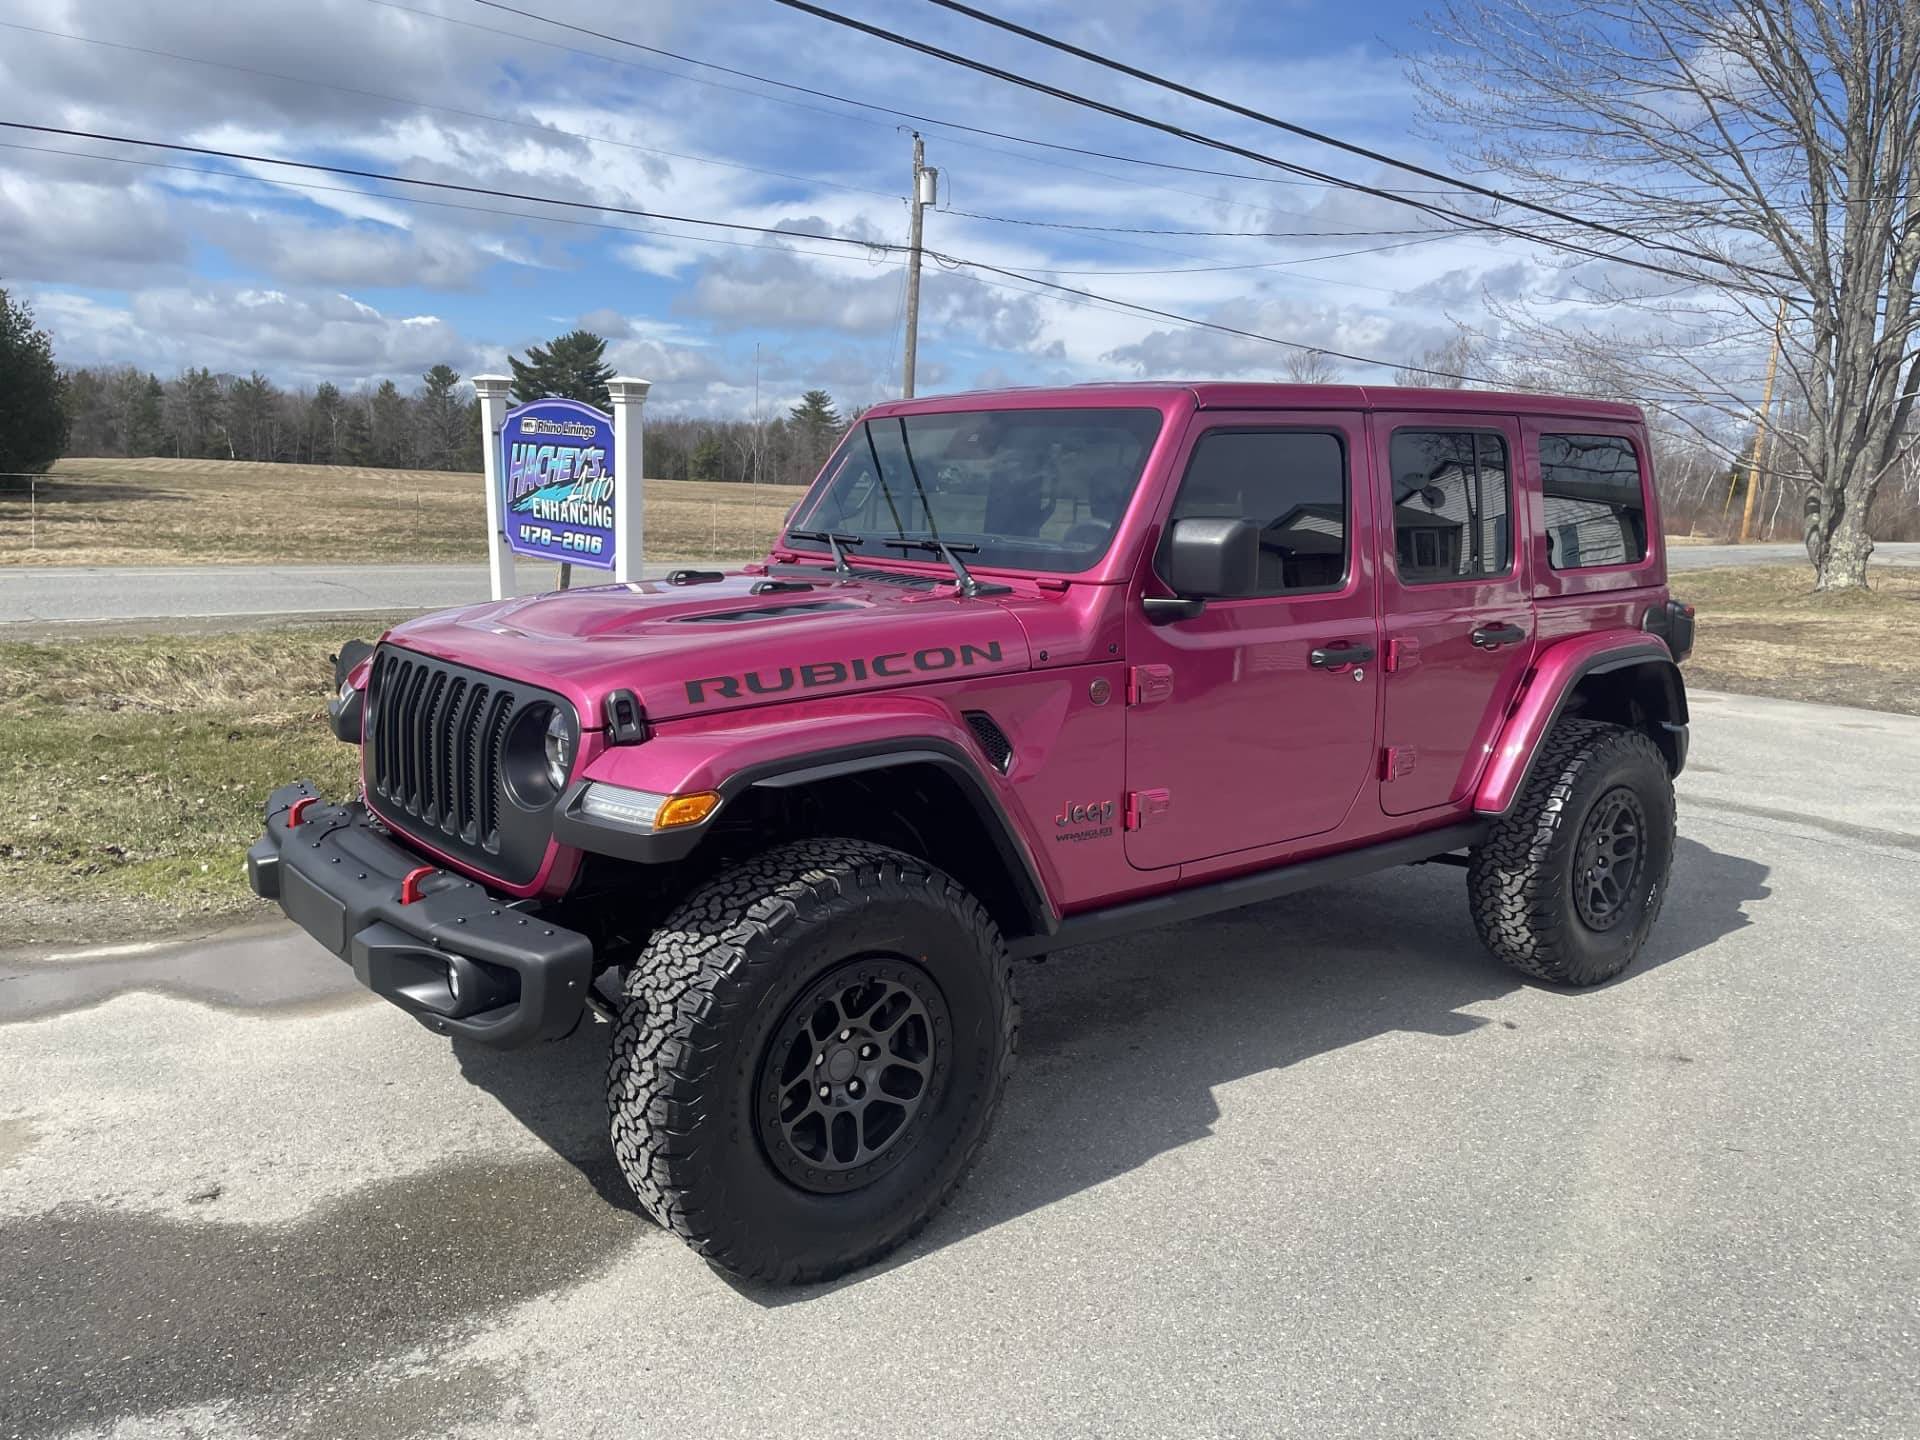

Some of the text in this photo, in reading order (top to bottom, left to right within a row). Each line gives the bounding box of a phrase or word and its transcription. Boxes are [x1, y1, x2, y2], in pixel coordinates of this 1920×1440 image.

[537, 420, 596, 440] Rhino Linings
[508, 443, 605, 503] HACHEY'S
[566, 466, 614, 510] Auto
[532, 498, 613, 529] ENHANCING
[520, 525, 603, 554] 478-2616
[685, 640, 1004, 705] RUBICON
[1055, 800, 1113, 827] Jeep
